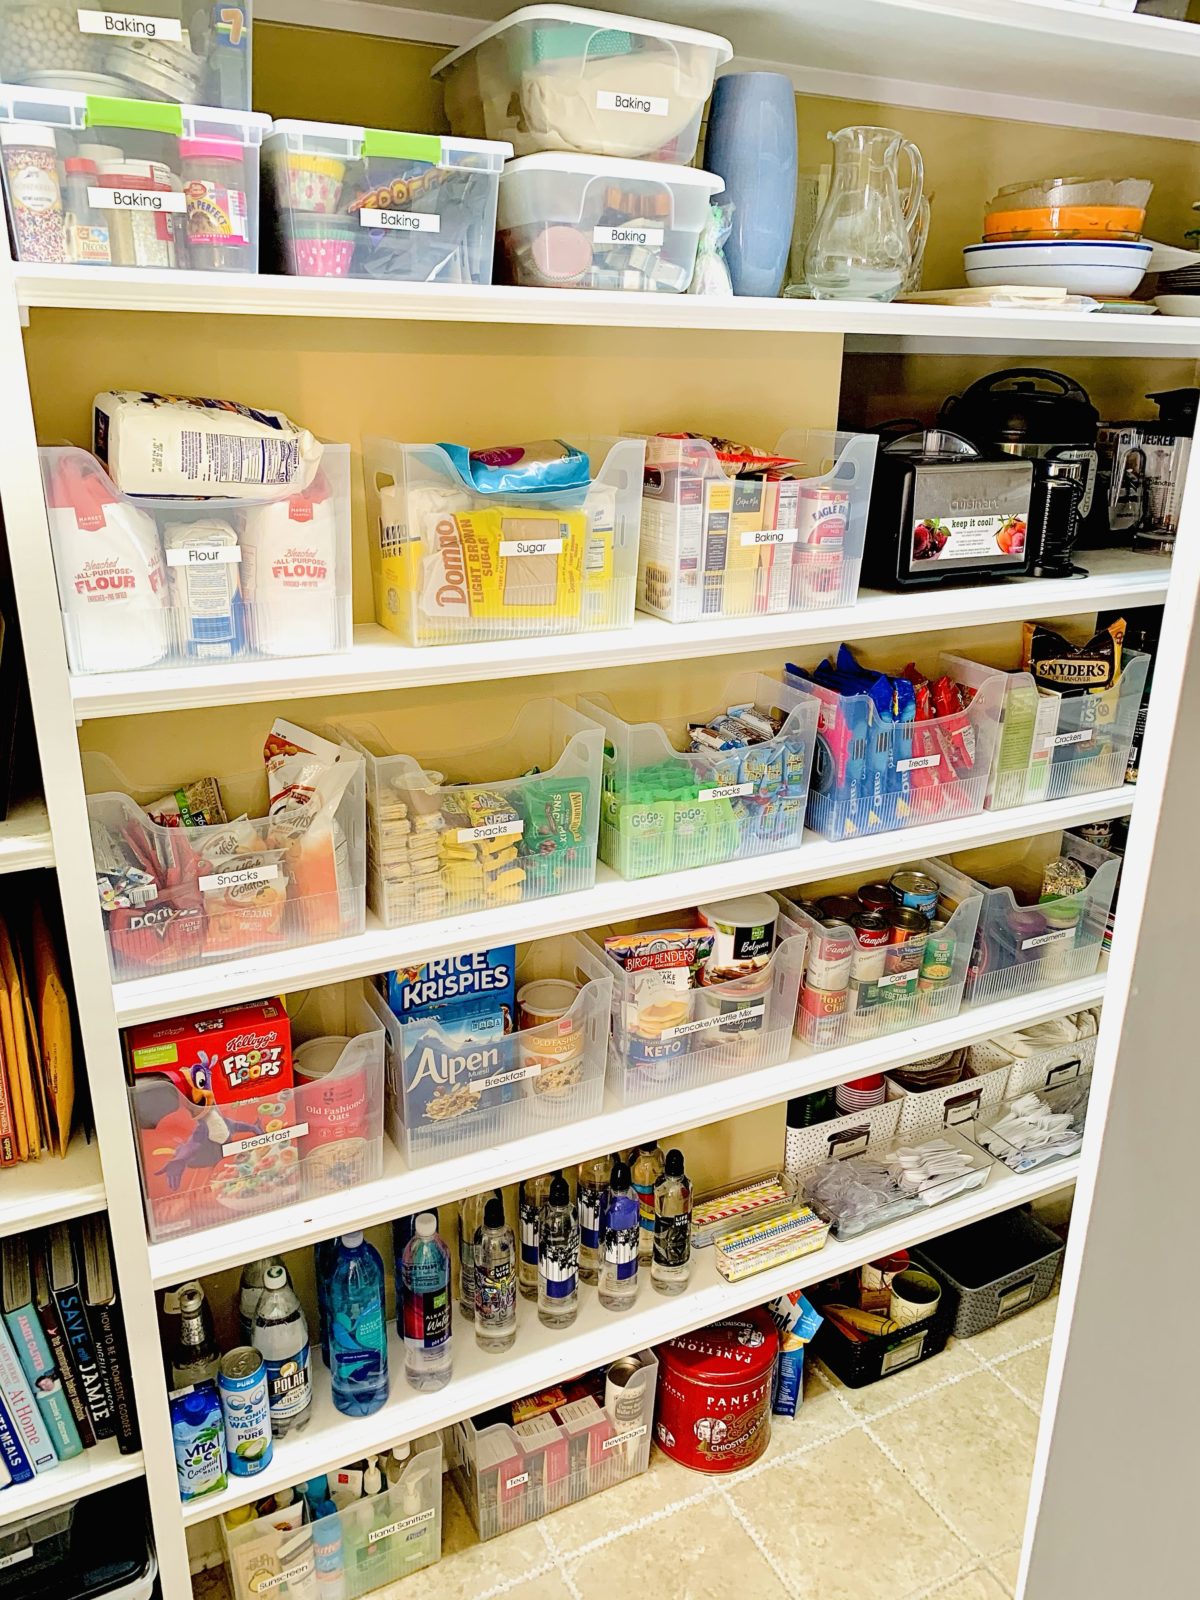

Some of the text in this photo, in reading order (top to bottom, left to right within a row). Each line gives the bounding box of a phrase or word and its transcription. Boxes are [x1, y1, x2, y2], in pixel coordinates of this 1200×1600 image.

[104, 16, 156, 36] Baking
[615, 95, 651, 112] Baking
[113, 191, 162, 209] Baking
[197, 200, 227, 225] PERFECT
[381, 213, 420, 229] Baking
[611, 229, 647, 243] Baking
[812, 505, 837, 521] EAGLE
[952, 520, 967, 529] keep
[970, 519, 976, 527] it
[755, 532, 784, 544] Baking
[189, 551, 219, 562] Flour
[478, 537, 493, 577] SUGAR
[517, 542, 546, 554] Sugar
[461, 519, 484, 603] LIGHT BROWN
[272, 565, 327, 578] FLOUR
[75, 576, 135, 594] FLOUR
[1039, 663, 1105, 677] SNYDER'S
[1054, 734, 1082, 744] Crackers
[908, 758, 928, 768] Treats
[712, 786, 741, 798] Snacks
[474, 825, 507, 838] Snacks
[217, 870, 258, 885] Snacks
[1031, 932, 1066, 946] Condiments
[428, 950, 487, 979] RICE
[626, 949, 695, 972] BIRCH BENDERS
[403, 966, 508, 1009] KRISPIES
[674, 1009, 753, 1034] Pancake/Waffle Mix
[226, 1032, 277, 1051] Kellogg's
[644, 1041, 681, 1057] KETO
[223, 1047, 281, 1074] FROOT
[229, 1061, 281, 1087] LOOPS
[407, 1047, 498, 1093] Alpen
[468, 1068, 490, 1079] Muesli
[485, 1069, 527, 1087] Breakfast
[306, 1093, 365, 1115] Old Fashioned
[328, 1112, 350, 1122] Oats
[4, 1137, 12, 1160] Scotch
[241, 1130, 291, 1150] Breakfast
[675, 1214, 688, 1222] LIFE
[496, 1263, 509, 1272] LIFE
[101, 1311, 111, 1331] HOW
[18, 1315, 45, 1371] JAMIE OLIVER
[105, 1333, 114, 1344] TO
[61, 1296, 87, 1345] SAVE
[79, 1363, 110, 1421] JAMIE
[107, 1345, 116, 1356] BE
[669, 1340, 751, 1364] PANETTONE
[111, 1364, 124, 1401] DOMESTIC
[236, 1379, 255, 1388] PURE
[273, 1371, 305, 1394] POLAR
[9, 1390, 40, 1445] At Home
[119, 1403, 132, 1437] GODDESS
[238, 1428, 264, 1441] PURE
[605, 1428, 644, 1448] Beverages
[711, 1431, 749, 1452] CHIOSTRO
[0, 1431, 22, 1466] MEALS
[185, 1441, 216, 1458] VITA
[509, 1475, 526, 1486] Tea
[370, 1510, 434, 1541] Hand Sanitizer
[259, 1564, 308, 1590] Sunscreen
